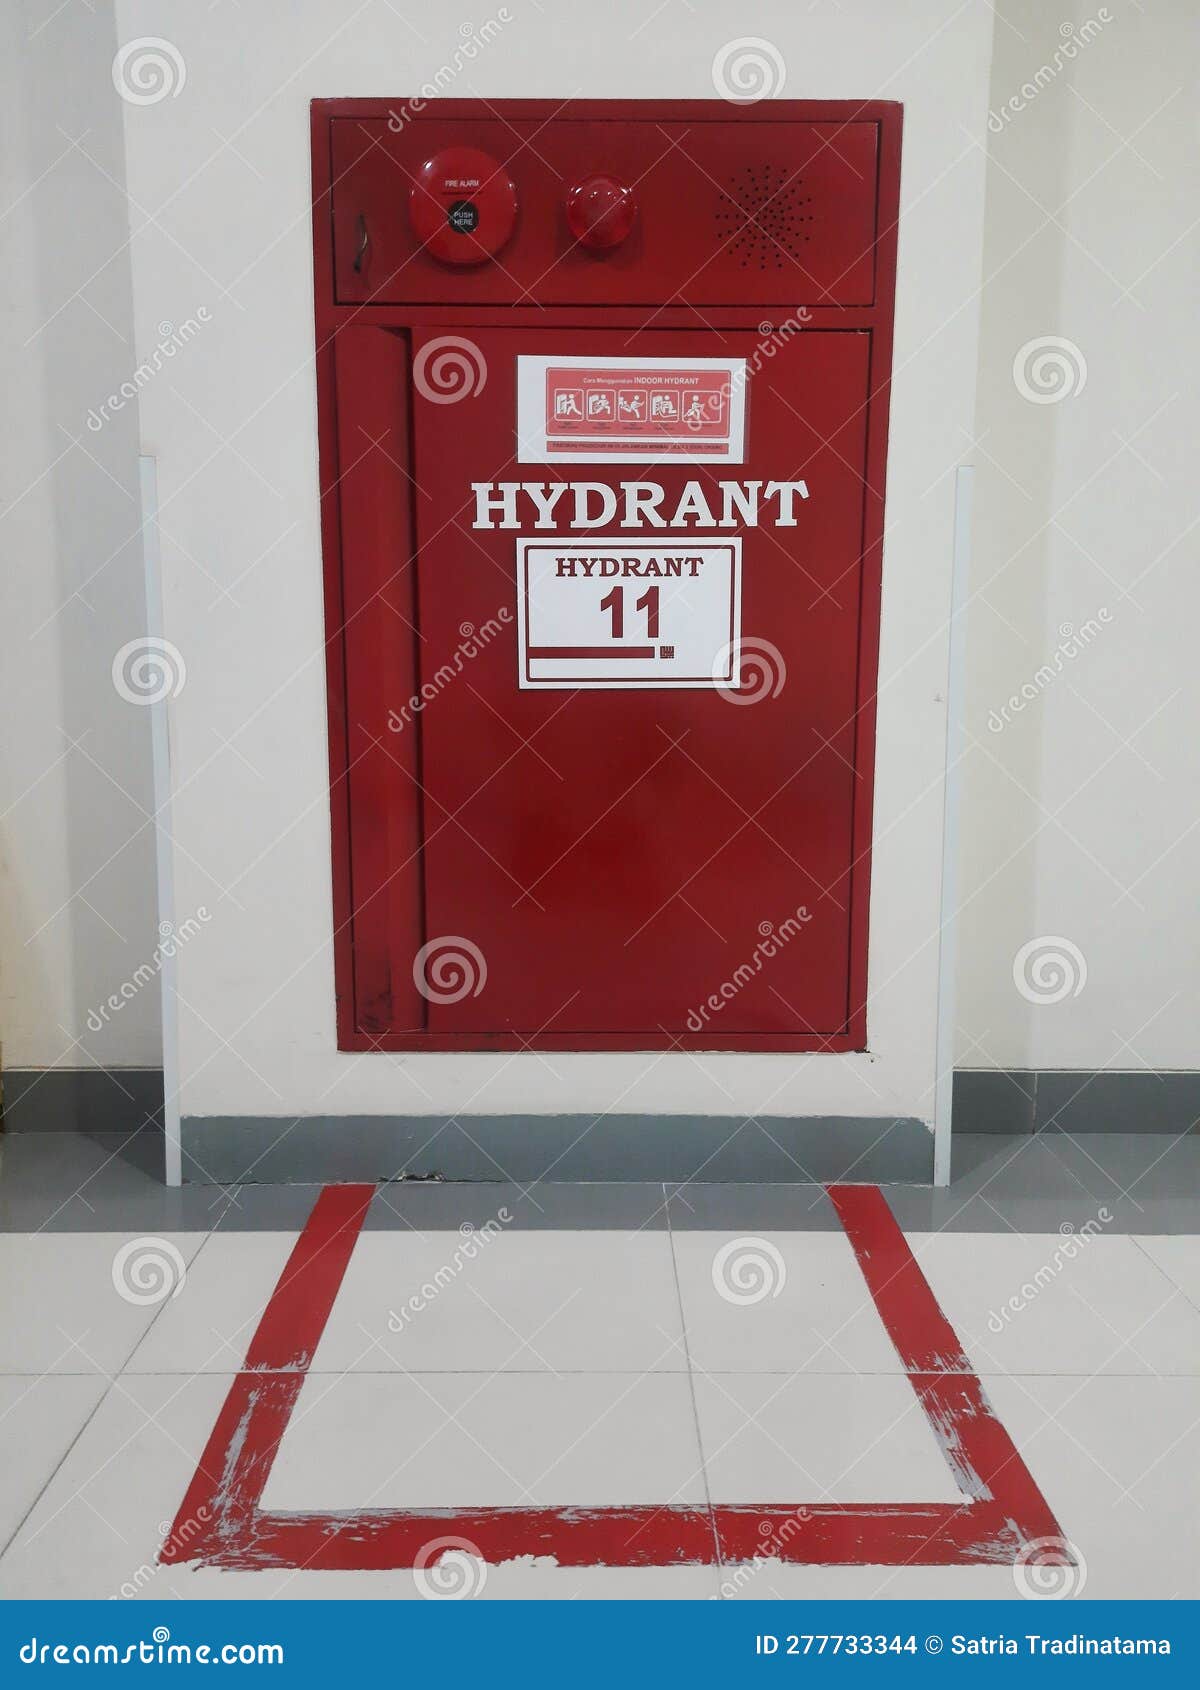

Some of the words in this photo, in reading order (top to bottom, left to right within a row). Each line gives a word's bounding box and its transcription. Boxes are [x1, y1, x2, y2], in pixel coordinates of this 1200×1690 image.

[445, 179, 458, 187] FIRE
[459, 179, 479, 187] ALARM
[634, 376, 664, 385] INDOOR
[664, 377, 699, 386] HYDRANT
[471, 480, 810, 529] HYDRANT
[555, 556, 704, 578] HYDRANT
[600, 585, 660, 639] 11
